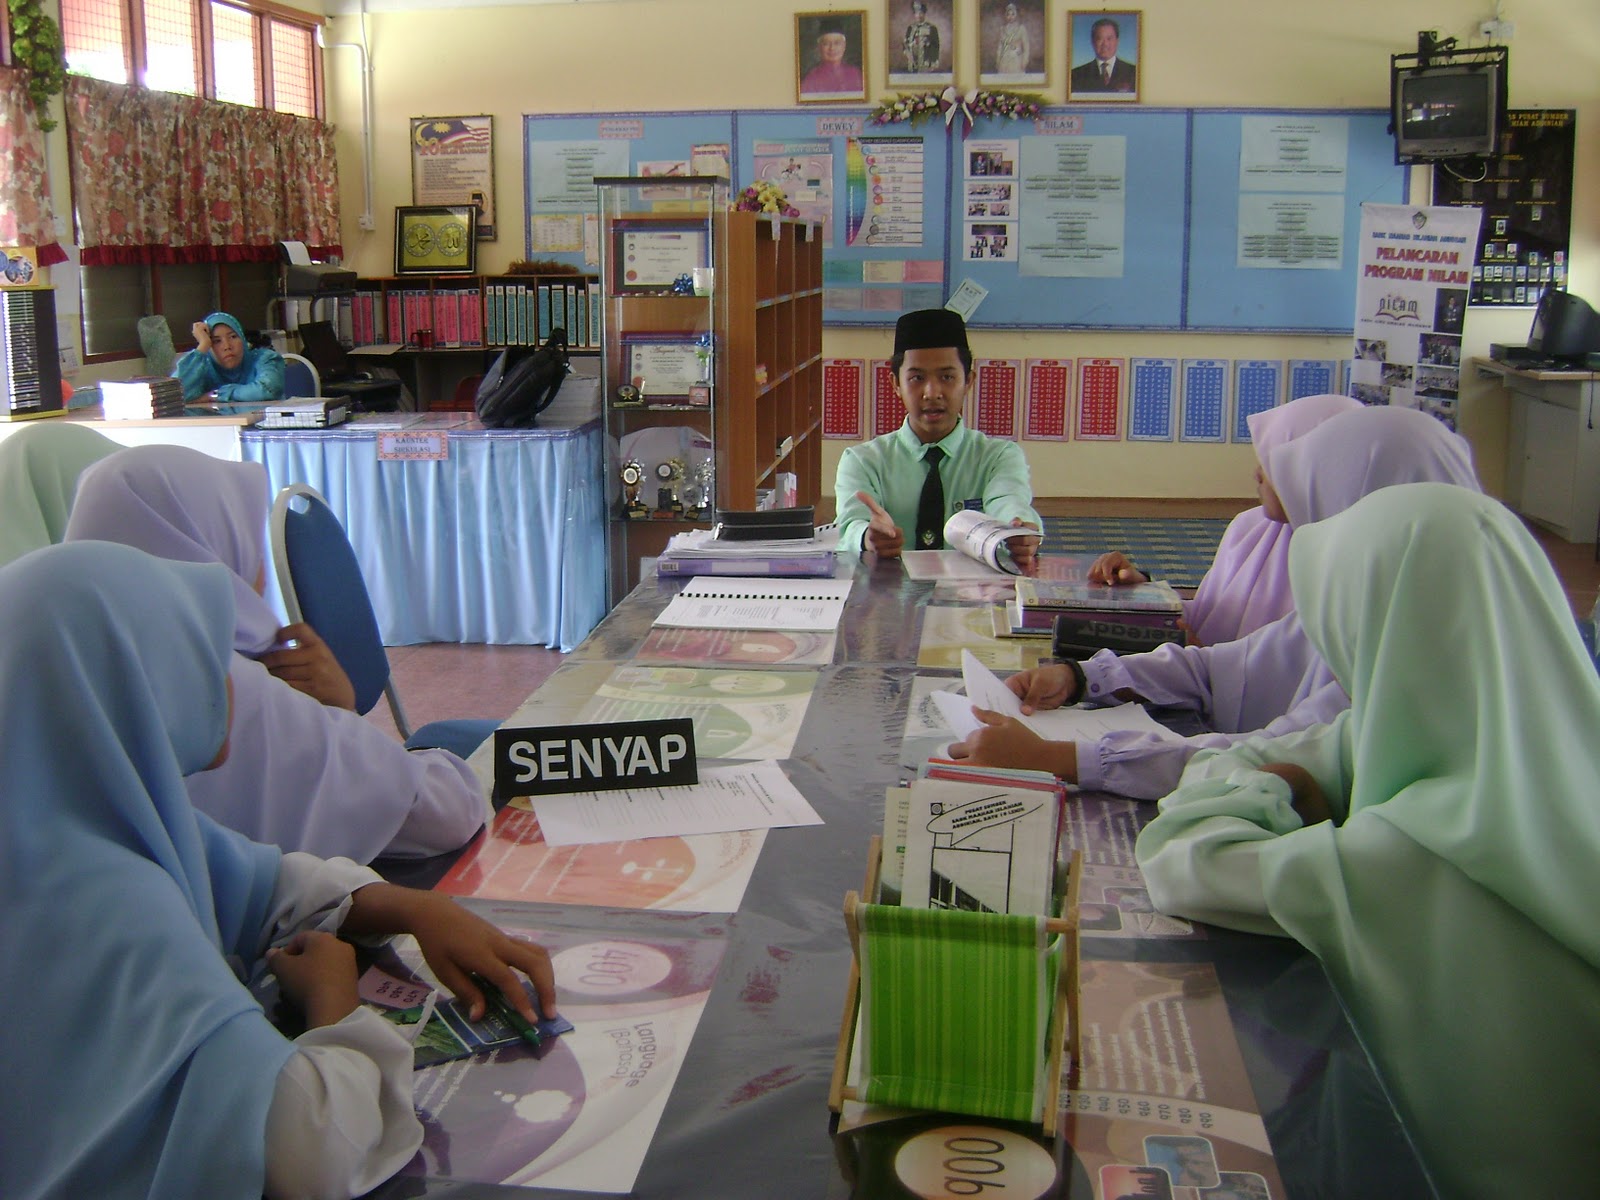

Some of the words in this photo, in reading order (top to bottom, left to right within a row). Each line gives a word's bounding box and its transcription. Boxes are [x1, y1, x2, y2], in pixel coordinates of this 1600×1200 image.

[822, 122, 855, 131] DEWEY
[1044, 121, 1074, 129] NILAM
[1376, 247, 1459, 265] PELANCARAN
[1364, 264, 1424, 281] PROGRAM
[1428, 269, 1469, 284] NILAM
[508, 734, 687, 782] SENYAP
[578, 949, 642, 986] 400
[625, 1021, 657, 1088] Language
[1158, 1104, 1171, 1120] 970
[1178, 1108, 1192, 1124] 980
[1200, 1112, 1213, 1129] 990
[943, 1137, 1006, 1195] 900
